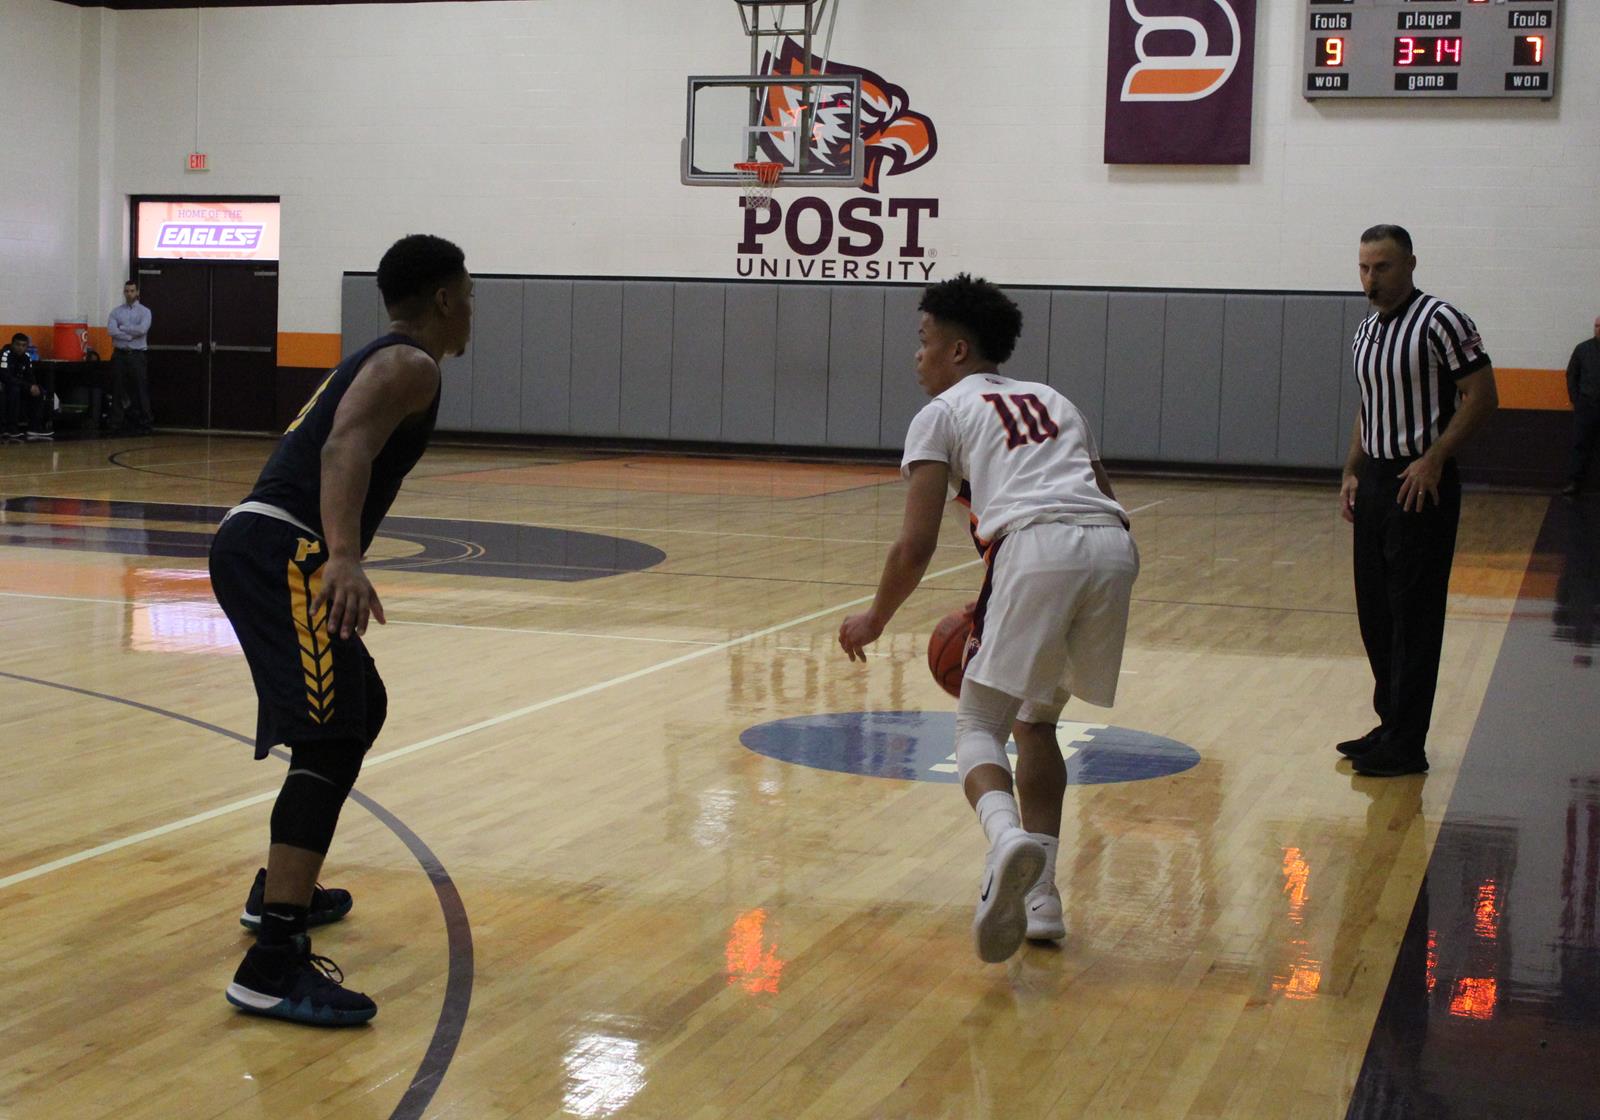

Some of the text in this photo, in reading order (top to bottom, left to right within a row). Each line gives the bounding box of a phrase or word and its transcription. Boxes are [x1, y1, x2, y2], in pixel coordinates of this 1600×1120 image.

[1315, 14, 1347, 28] fouls
[1405, 13, 1452, 28] player
[1513, 12, 1547, 27] fouls
[1325, 38, 1342, 65] 9
[1526, 37, 1542, 62] 7
[1315, 75, 1341, 87] won
[1408, 74, 1444, 89] game
[1513, 75, 1540, 87] won
[190, 154, 206, 169] EXIT
[178, 209, 242, 219] HOME OF THE
[737, 196, 939, 257] POST
[161, 227, 258, 245] EAGLES
[736, 257, 936, 280] UNIVERSITY
[981, 393, 1058, 451] 10
